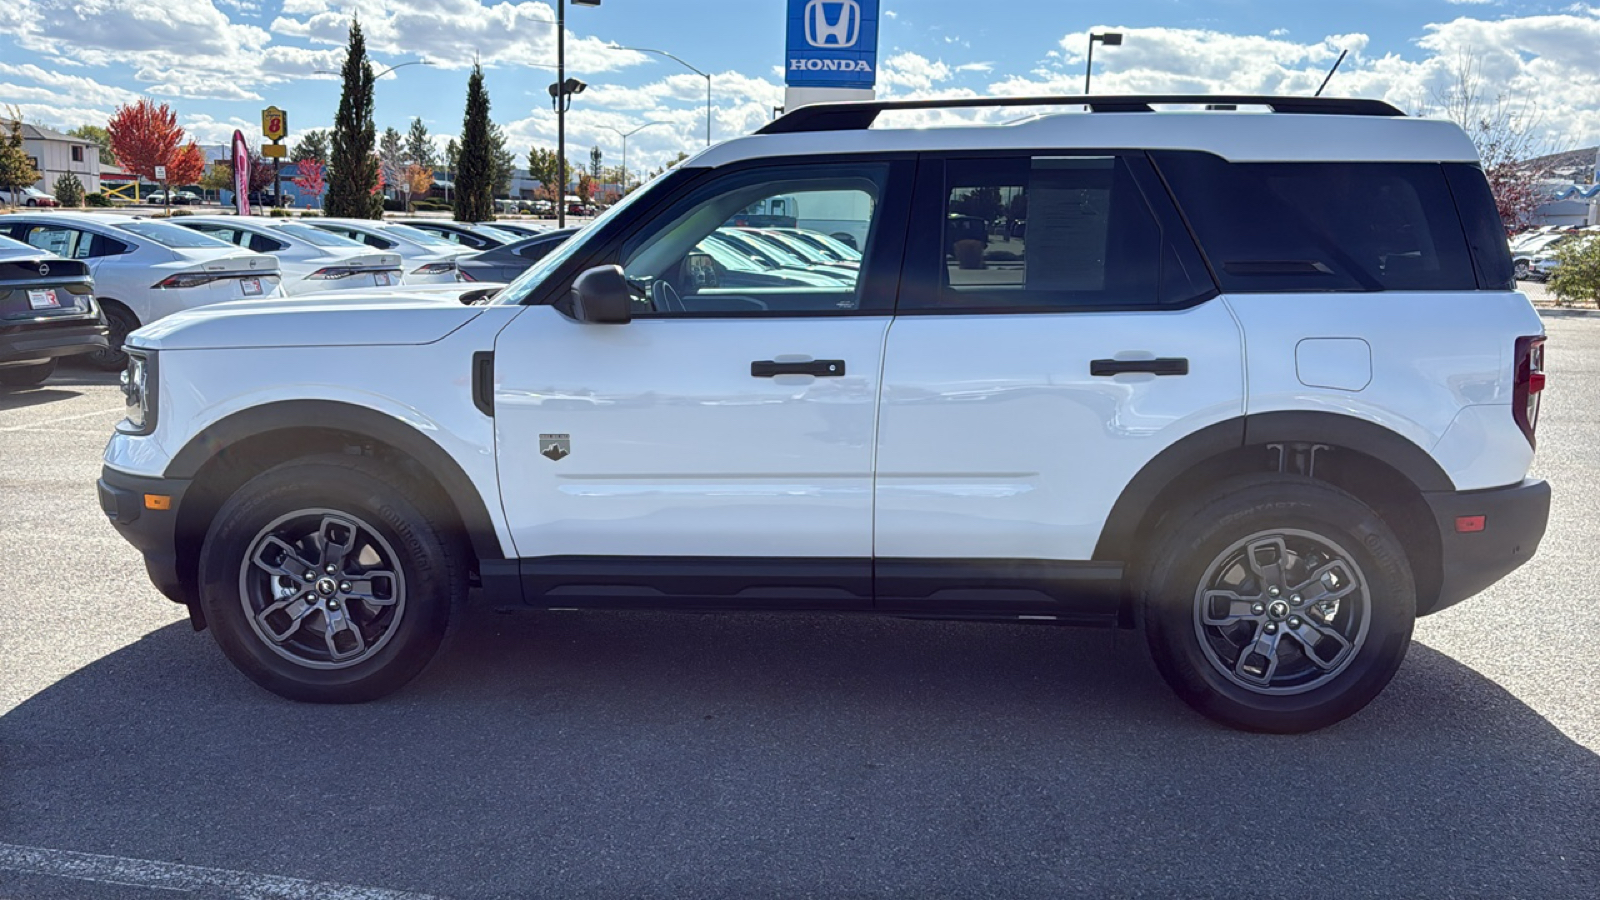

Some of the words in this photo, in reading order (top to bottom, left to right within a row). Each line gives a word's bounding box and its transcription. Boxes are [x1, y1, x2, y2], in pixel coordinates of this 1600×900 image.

[789, 58, 872, 72] HONDA
[268, 118, 281, 133] 8
[379, 503, 434, 573] Continental
